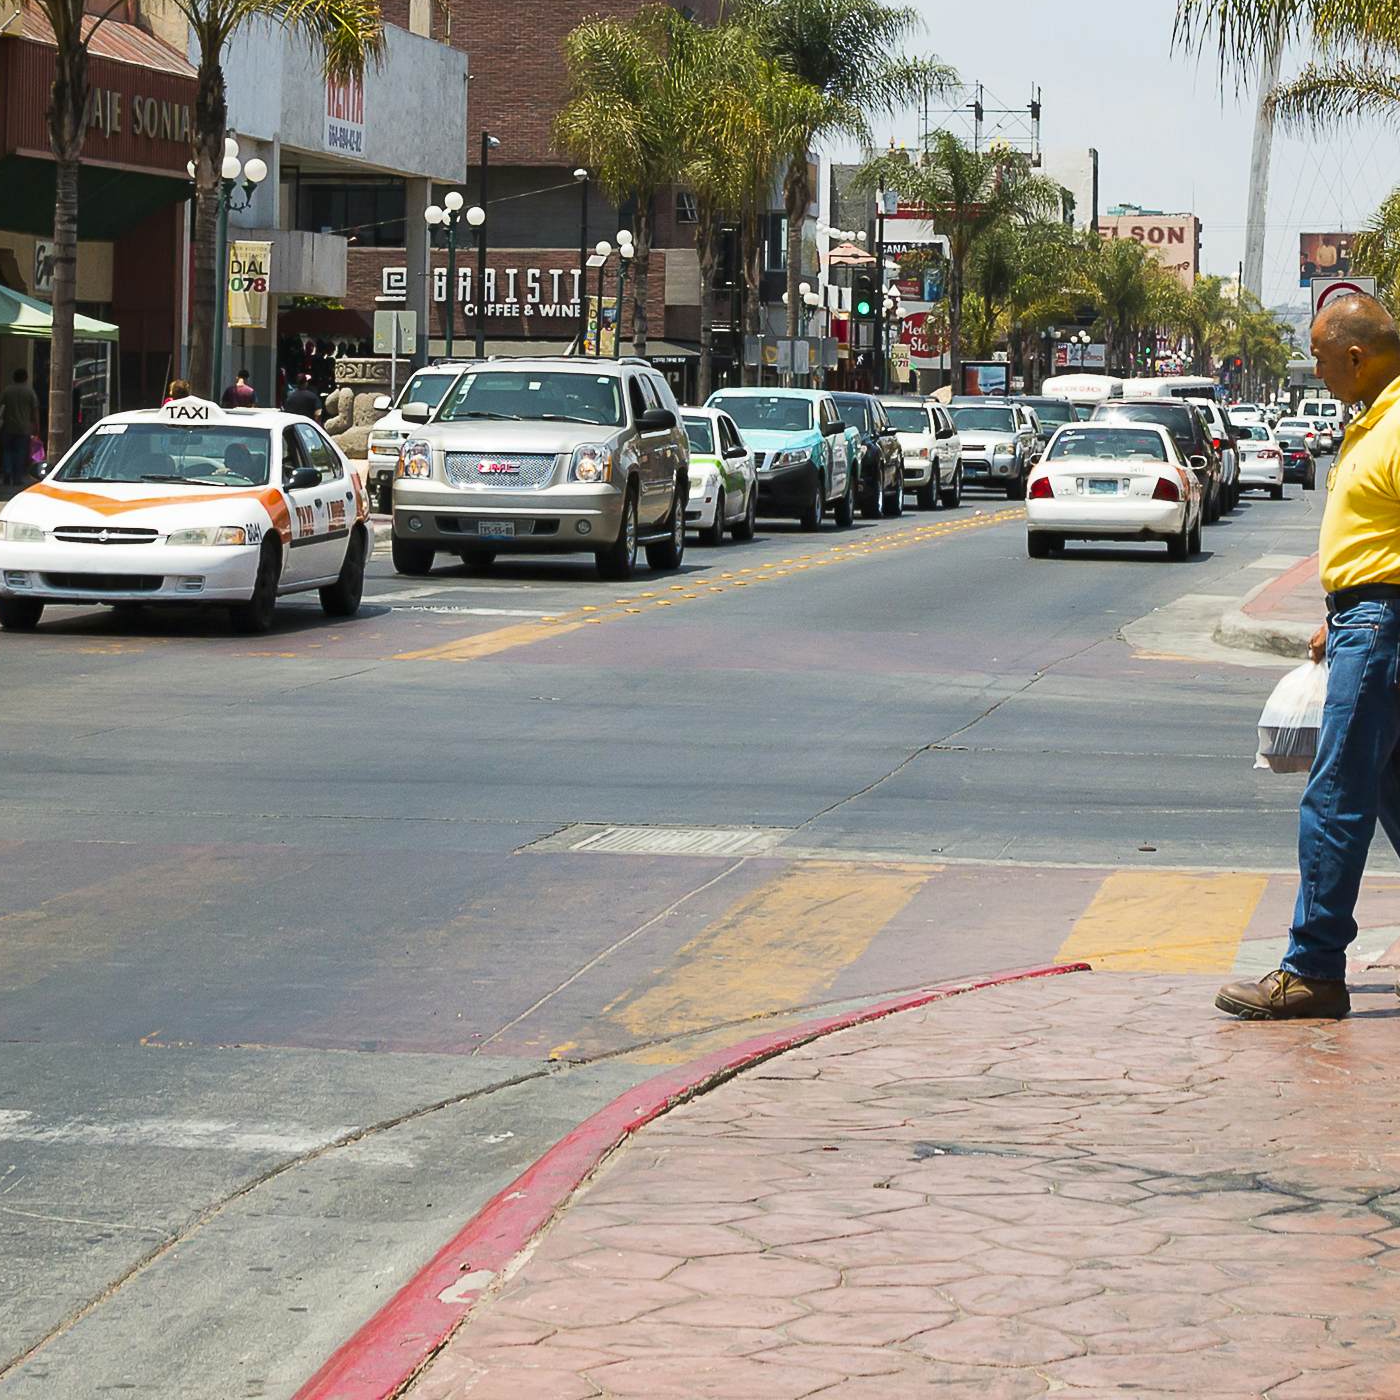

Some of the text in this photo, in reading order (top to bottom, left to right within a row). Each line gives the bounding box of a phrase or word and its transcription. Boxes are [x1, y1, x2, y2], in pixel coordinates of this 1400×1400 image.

[89, 87, 191, 145] AJE SONIA
[230, 260, 269, 276] DIAL
[230, 277, 267, 293] 078
[523, 303, 534, 316] &
[539, 303, 581, 318] WINE
[166, 406, 209, 420] TAXI
